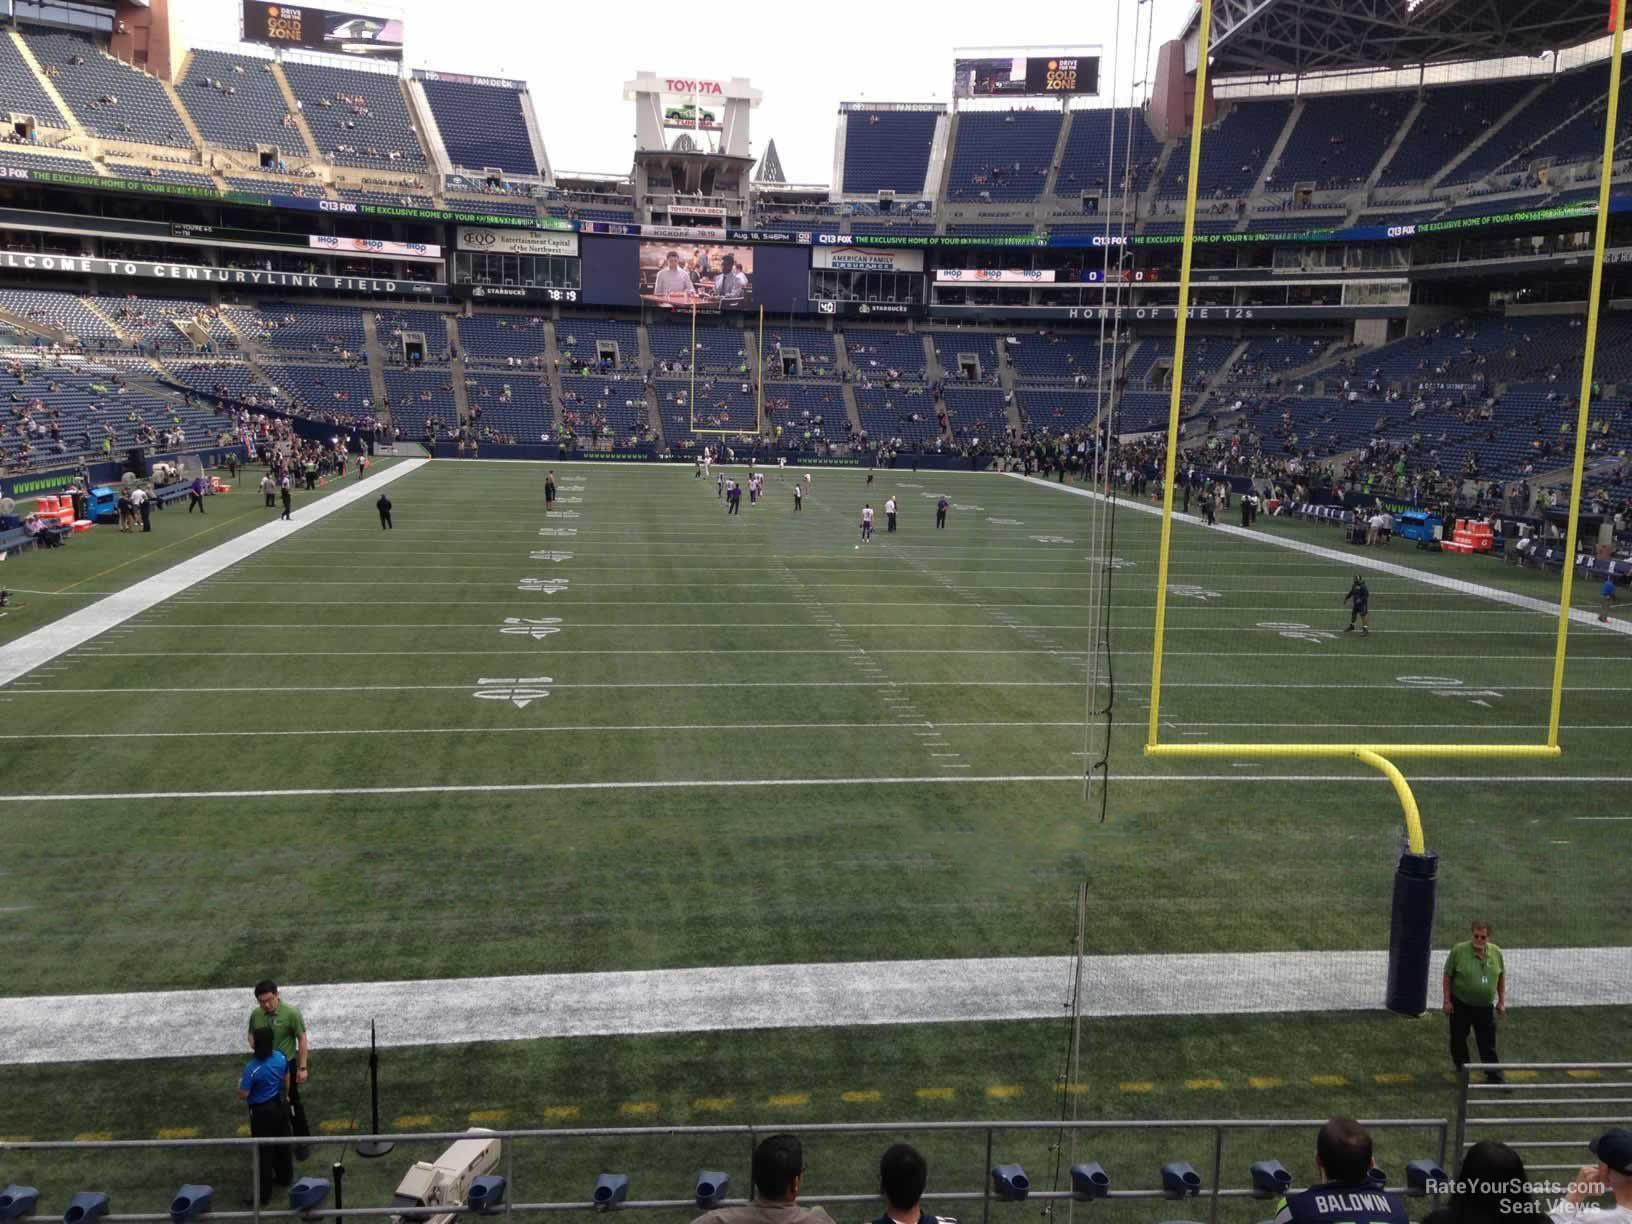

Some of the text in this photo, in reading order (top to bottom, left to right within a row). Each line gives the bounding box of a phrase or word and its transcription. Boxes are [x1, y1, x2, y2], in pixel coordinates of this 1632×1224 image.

[268, 18, 301, 29] GOLD
[268, 28, 301, 40] ZONE
[1047, 70, 1077, 80] GOLD
[666, 80, 722, 94] TOYOTA
[1046, 80, 1076, 90] ZONE
[9, 169, 28, 179] FOX
[33, 171, 50, 180] THE
[52, 173, 99, 185] EXCLUSIVE
[101, 179, 126, 189] HOME
[128, 181, 138, 190] OF
[141, 183, 165, 192] YOUR
[320, 200, 475, 222] Q13 FOX THE EXCLUSIVE HOME OF YOUR
[1387, 214, 1509, 237] Q13 FOX THE EXCLUSIVE HOME OF YOUR
[501, 236, 570, 248] Entertainment Capital
[819, 235, 836, 243] Q13
[837, 235, 852, 243] FOX
[870, 236, 906, 244] EXCLUSIVE
[1092, 236, 1110, 245] Q13
[1111, 237, 1127, 245] FOX
[1146, 236, 1184, 244] EXCLUSIVE
[529, 245, 561, 253] Northwest
[0, 254, 91, 272] LCOME
[108, 262, 137, 275] TO
[154, 266, 319, 288] CENTURYLINK
[334, 278, 396, 292] FIELD
[1089, 272, 1097, 280] 0
[1135, 272, 1143, 280] 0
[1070, 309, 1122, 319] HOME
[1136, 309, 1159, 318] OF
[1224, 309, 1253, 318] 12s
[1315, 1193, 1392, 1213] BALDWIN
